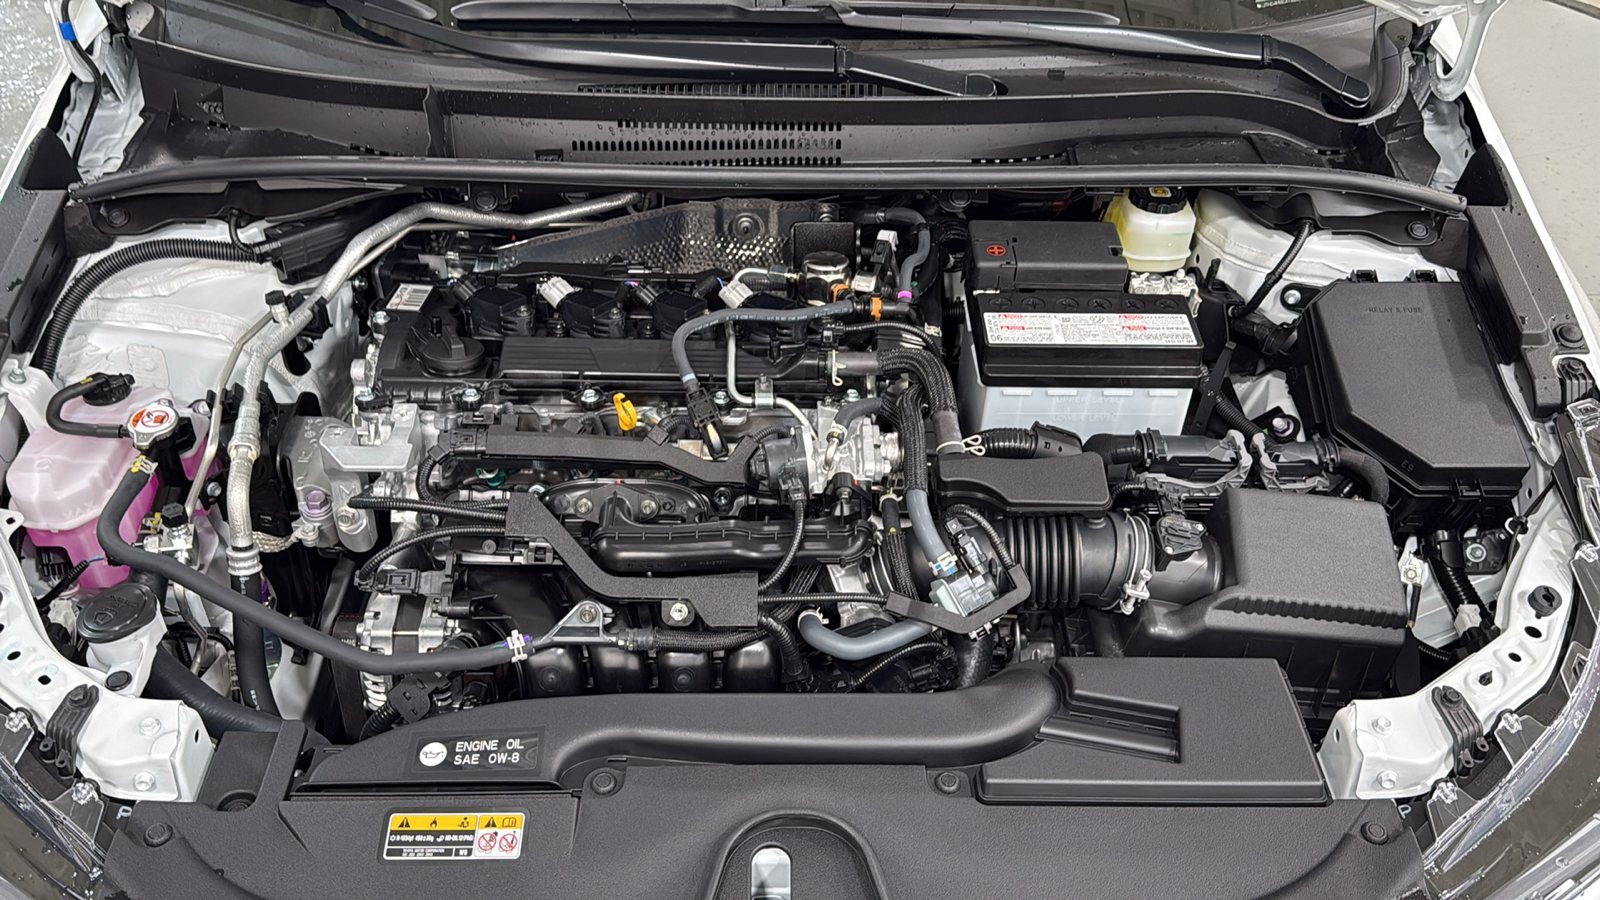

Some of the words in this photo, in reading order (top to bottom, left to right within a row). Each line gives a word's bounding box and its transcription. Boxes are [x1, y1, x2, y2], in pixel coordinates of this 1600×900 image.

[1092, 396, 1121, 404] LEVEL
[1089, 414, 1117, 422] LEVEL
[1400, 459, 1415, 472] E9
[62, 500, 96, 519] MAX
[455, 740, 499, 752] ENGINE
[506, 738, 524, 750] OIL
[453, 754, 480, 765] SAE
[488, 752, 520, 764] 0W-8
[115, 805, 133, 820] P
[1397, 804, 1412, 819] P
